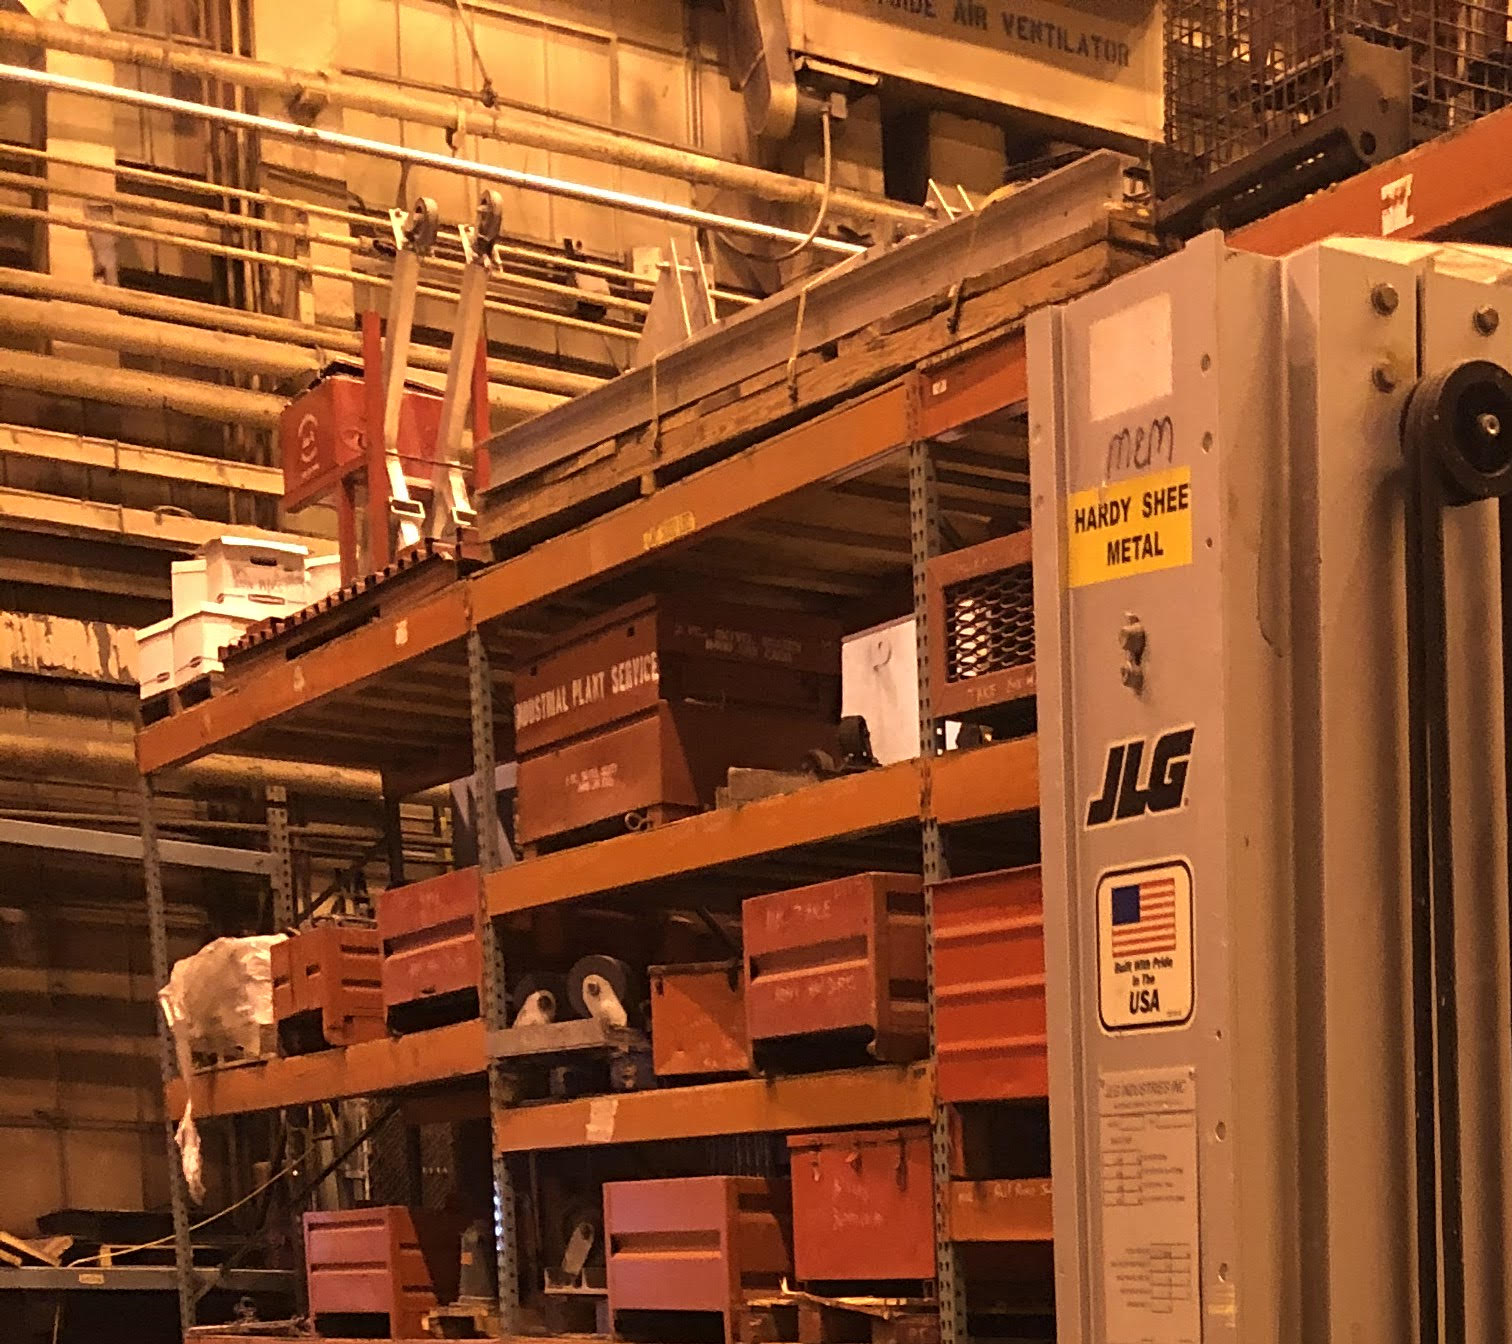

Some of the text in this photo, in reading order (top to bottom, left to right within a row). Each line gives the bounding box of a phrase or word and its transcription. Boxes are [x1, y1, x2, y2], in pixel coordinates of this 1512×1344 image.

[953, 2, 988, 30] AIR
[1002, 11, 1129, 67] VENTILATOR
[1074, 482, 1190, 534] HARDY SHEE
[1107, 531, 1164, 566] METAL
[572, 671, 605, 706] PLANT
[611, 651, 660, 694] SERVICE
[1086, 727, 1195, 827] JLG
[1129, 989, 1160, 1014] USA
